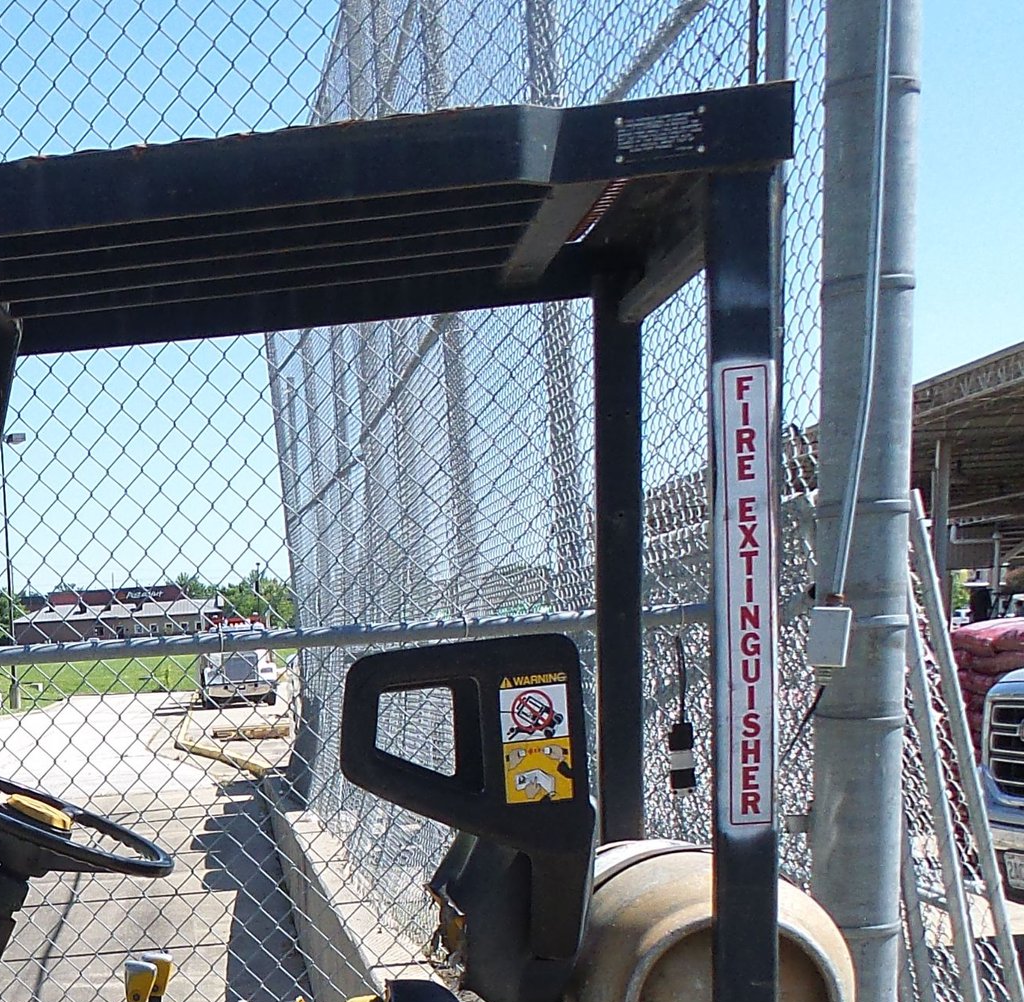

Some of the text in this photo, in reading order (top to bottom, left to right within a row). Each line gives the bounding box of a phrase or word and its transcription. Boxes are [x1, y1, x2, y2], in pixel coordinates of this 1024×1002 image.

[512, 672, 567, 687] WARNING
[736, 376, 761, 815] FIRE EXTINGUISHER
